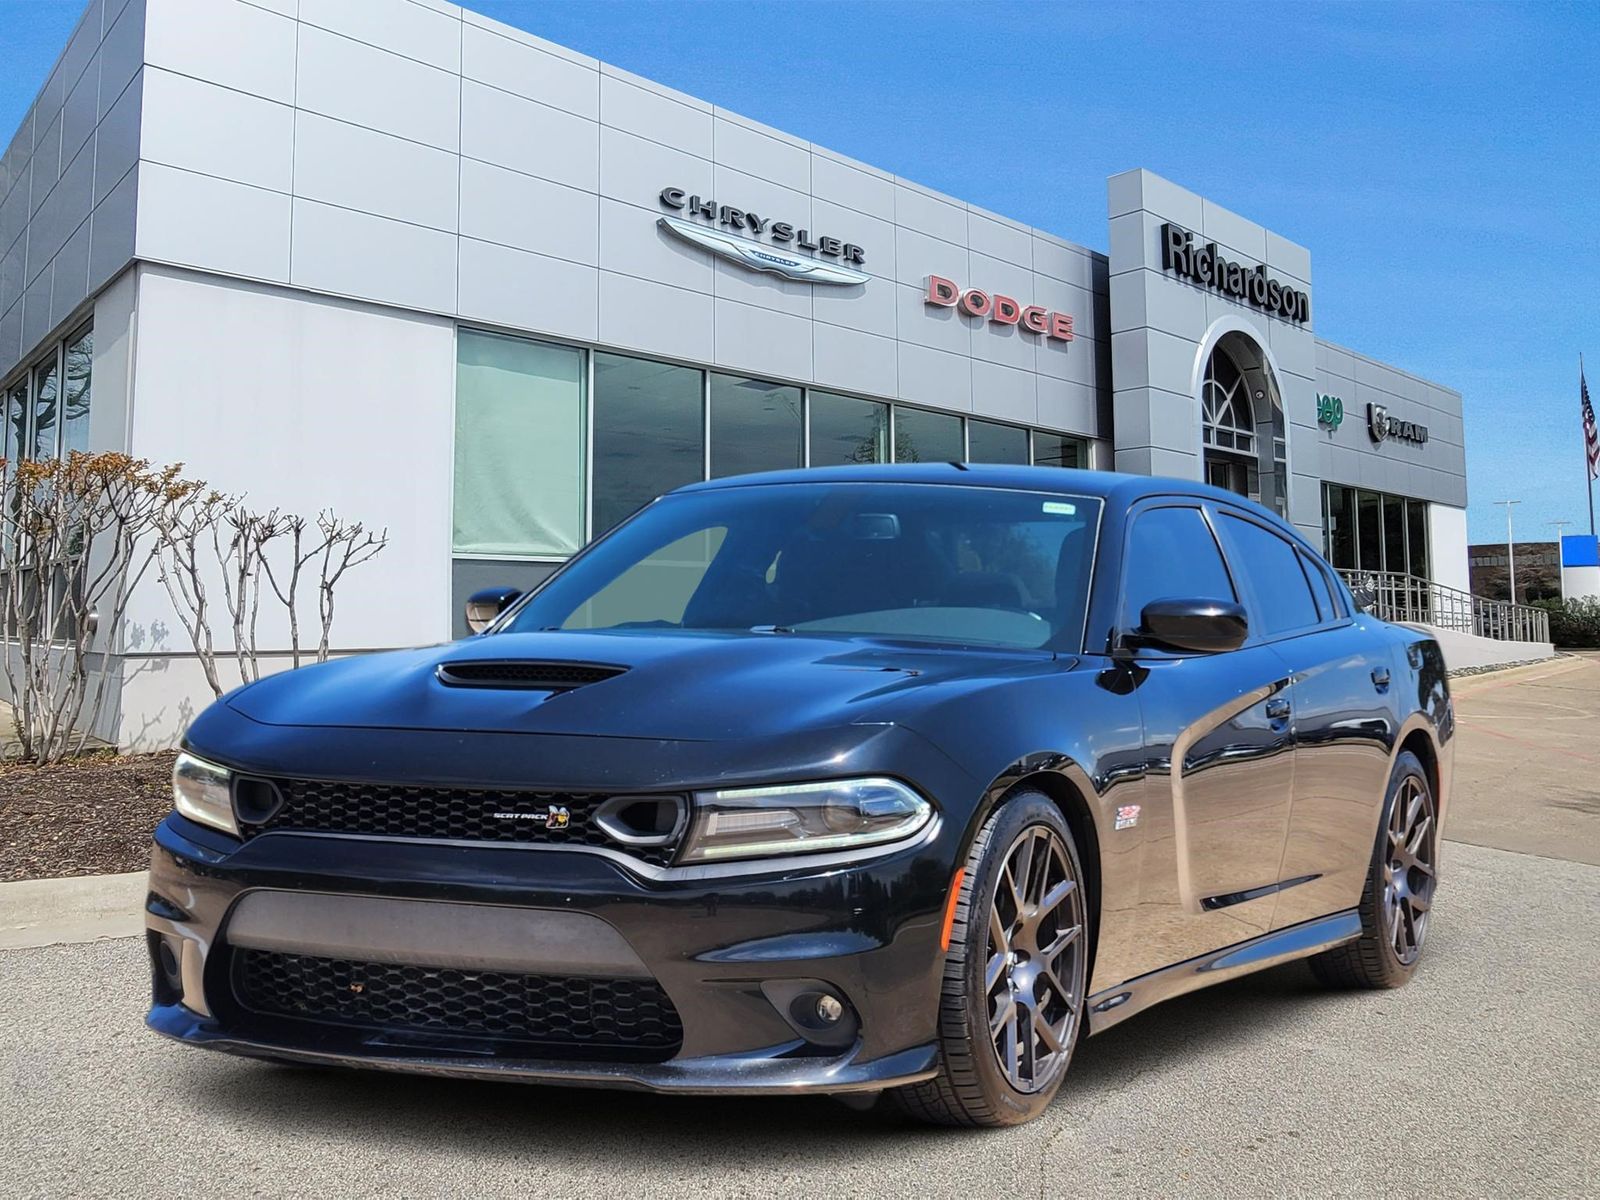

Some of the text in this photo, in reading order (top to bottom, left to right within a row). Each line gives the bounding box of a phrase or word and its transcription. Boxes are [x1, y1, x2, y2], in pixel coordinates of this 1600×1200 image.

[659, 186, 865, 264] CHRYSLER
[924, 275, 1074, 342] DODGE
[1161, 223, 1309, 323] Richardson
[1388, 416, 1428, 443] RAM
